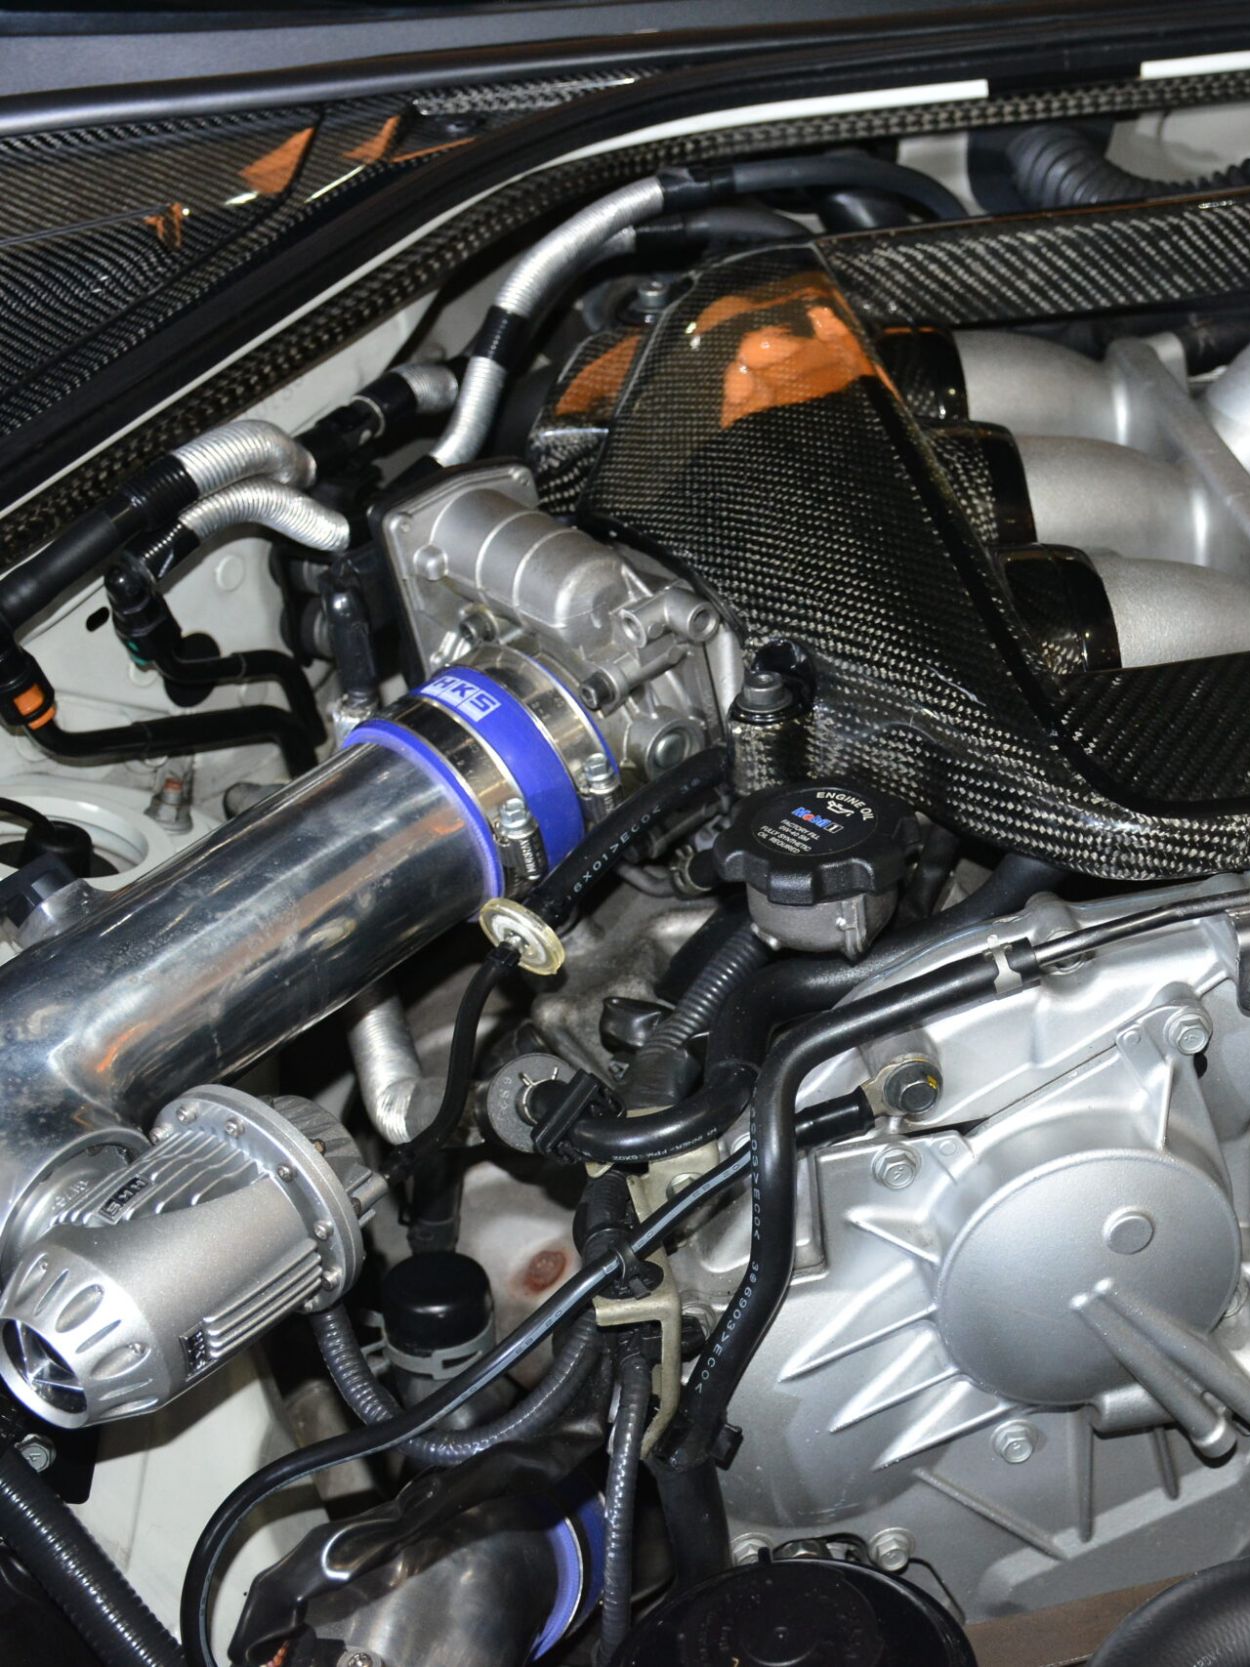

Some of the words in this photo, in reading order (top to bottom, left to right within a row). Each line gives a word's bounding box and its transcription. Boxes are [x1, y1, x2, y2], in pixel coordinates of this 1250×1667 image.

[431, 676, 497, 714] HKS
[791, 806, 832, 829] Mobil
[816, 791, 866, 809] ENGINE
[860, 807, 875, 821] OIL
[757, 831, 769, 840] OIL
[760, 825, 780, 836] FULLY
[106, 1178, 147, 1217] HKS
